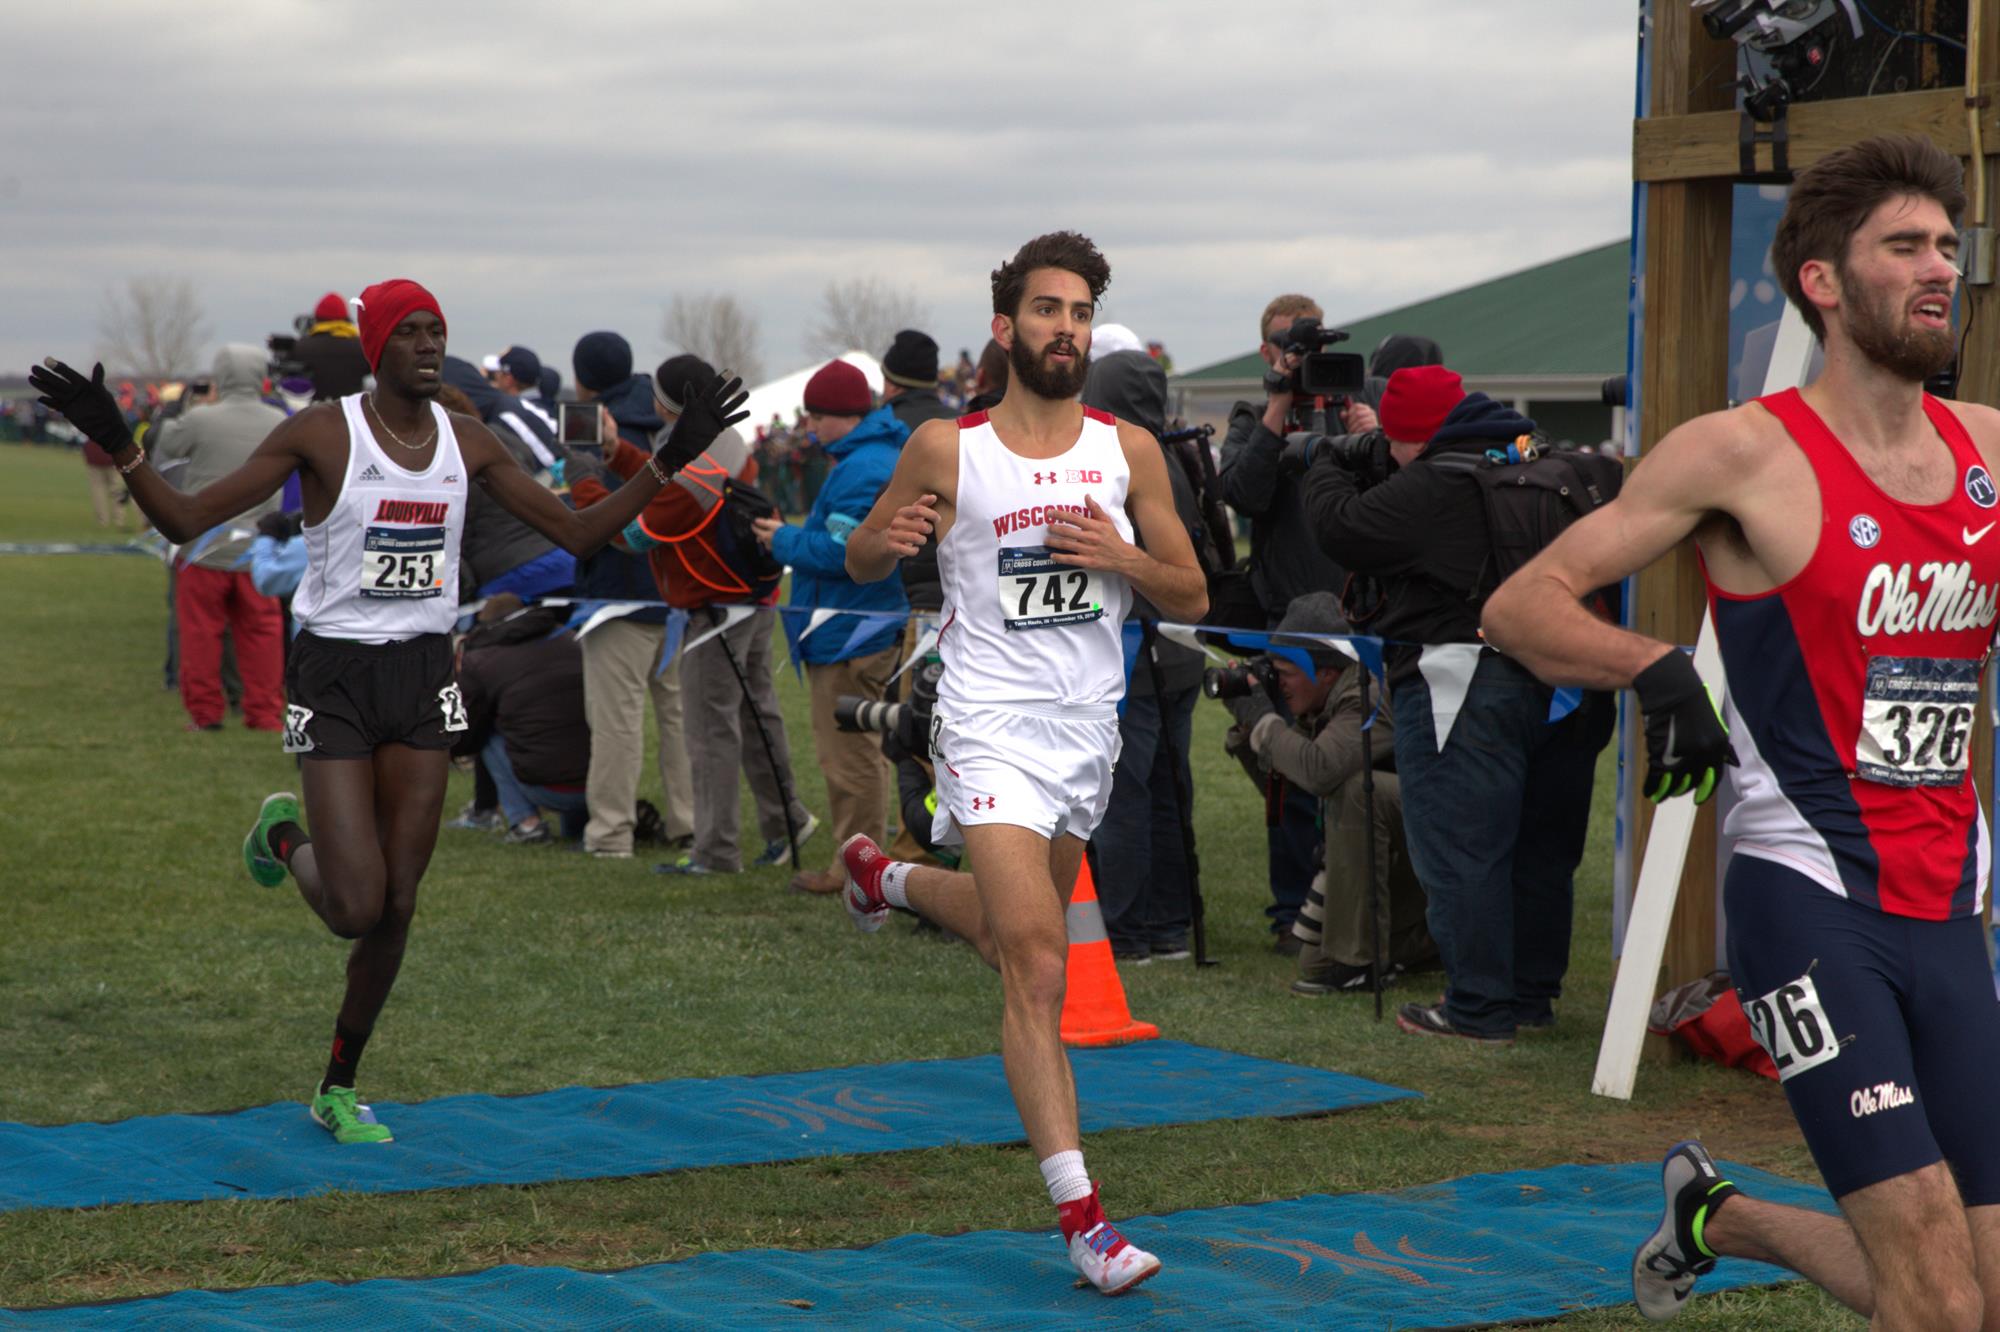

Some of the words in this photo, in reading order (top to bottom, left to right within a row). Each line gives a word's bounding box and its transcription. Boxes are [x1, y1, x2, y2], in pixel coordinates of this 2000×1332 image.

[1968, 474, 1994, 500] TY
[373, 499, 449, 525] LOUISVILLE
[993, 504, 1092, 538] WISCO
[1849, 515, 1880, 547] SEC
[375, 554, 434, 589] 253
[1016, 571, 1091, 616] 742
[1857, 562, 1919, 637] Ole
[1917, 560, 2000, 633] Miss
[1883, 705, 1971, 767] 326
[1851, 1087, 1878, 1118] Ole
[1873, 1081, 1914, 1110] Miss
